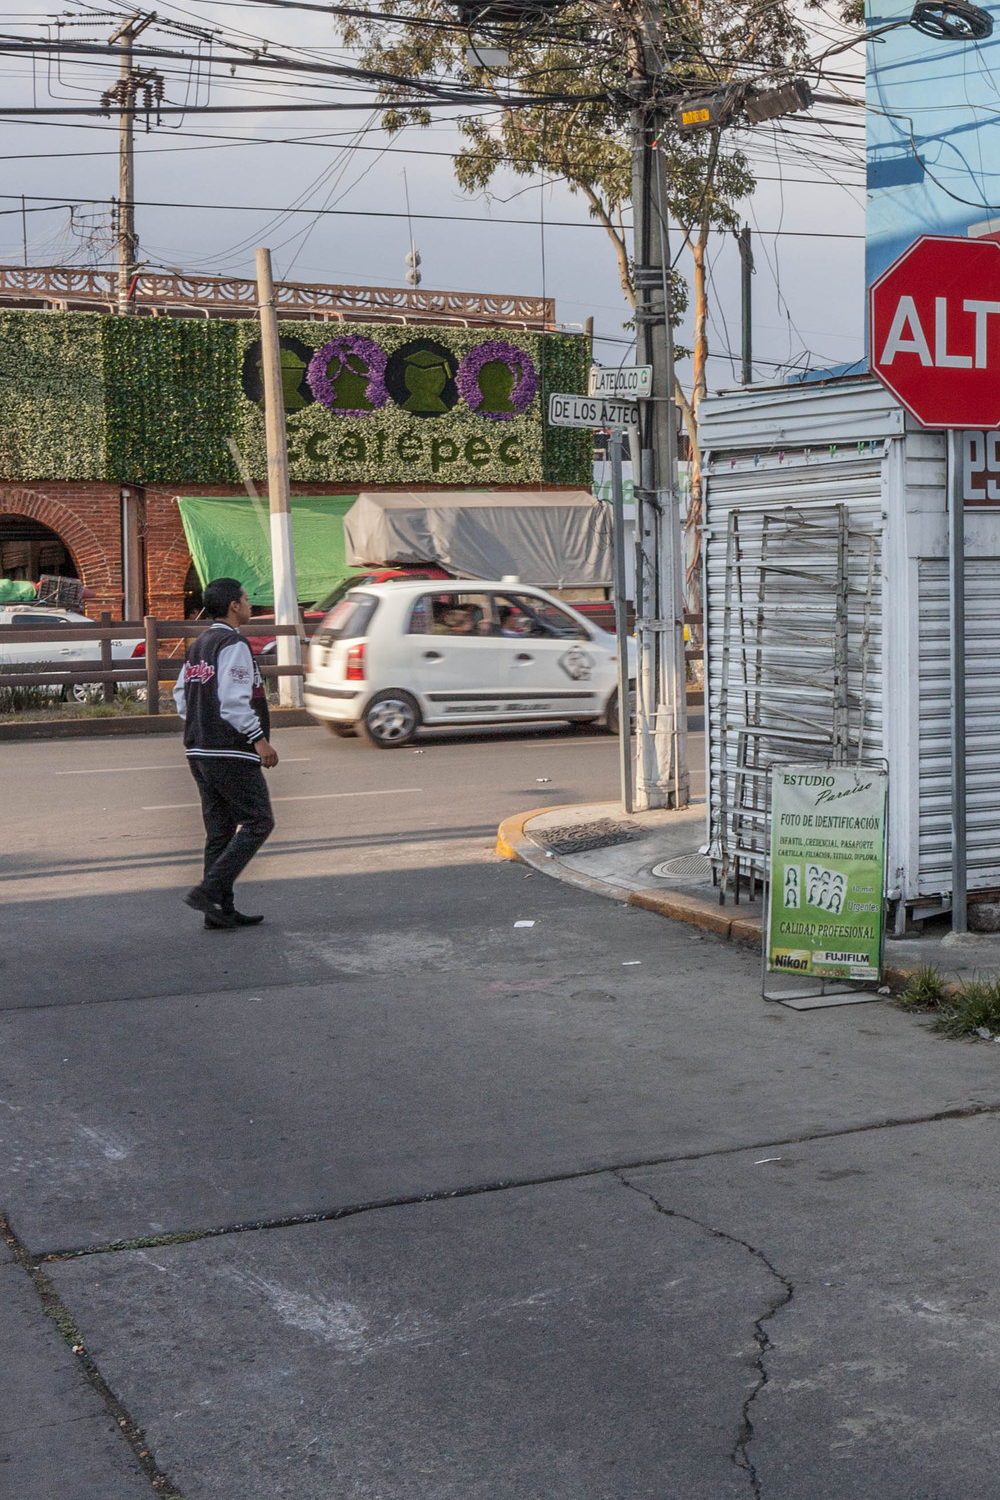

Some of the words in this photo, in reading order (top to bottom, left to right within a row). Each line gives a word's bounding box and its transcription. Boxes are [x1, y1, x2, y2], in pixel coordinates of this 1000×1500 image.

[555, 401, 570, 418] DE
[574, 403, 596, 421] LOS
[600, 404, 638, 424] AZTEC
[783, 774, 835, 787] ESTUDIO
[814, 782, 873, 806] Paraiso
[780, 813, 801, 826] FOTO
[803, 815, 813, 827] DE
[815, 815, 880, 830] IDENTIFICACIÓN
[841, 841, 874, 849] PASAPORTE
[847, 901, 879, 913] Urgentes
[780, 921, 816, 936] CALIDAD
[818, 924, 875, 939] PROFESIONAL
[775, 955, 808, 969] Nikon
[825, 952, 869, 963] FUJIFILM
